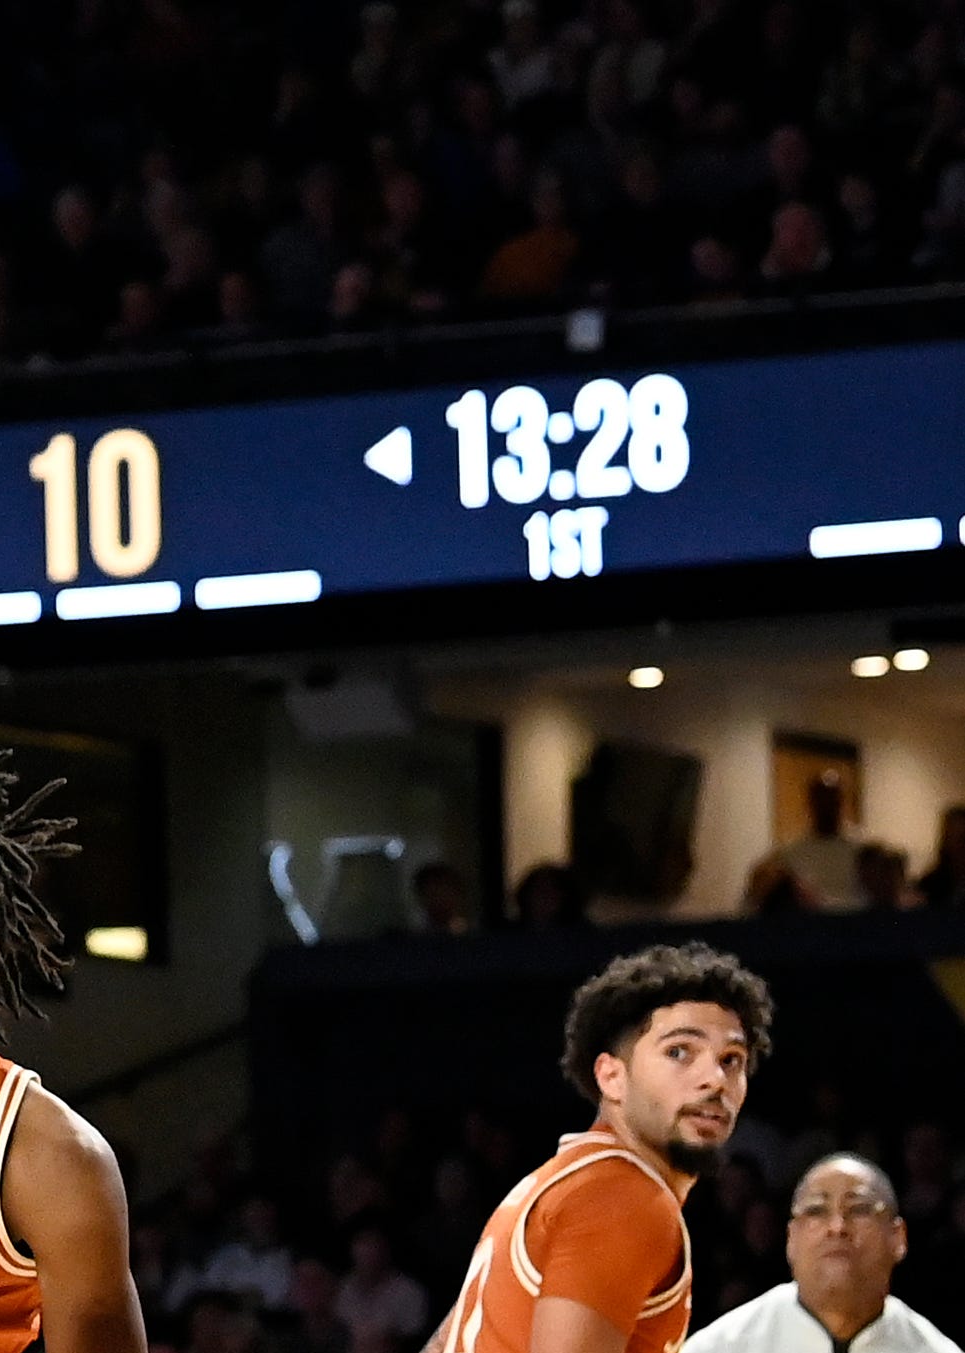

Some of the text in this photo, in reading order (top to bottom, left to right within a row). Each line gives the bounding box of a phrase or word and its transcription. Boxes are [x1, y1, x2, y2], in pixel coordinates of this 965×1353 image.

[29, 428, 163, 584] 10
[445, 373, 691, 509] 13:28
[523, 506, 610, 581] 1ST
